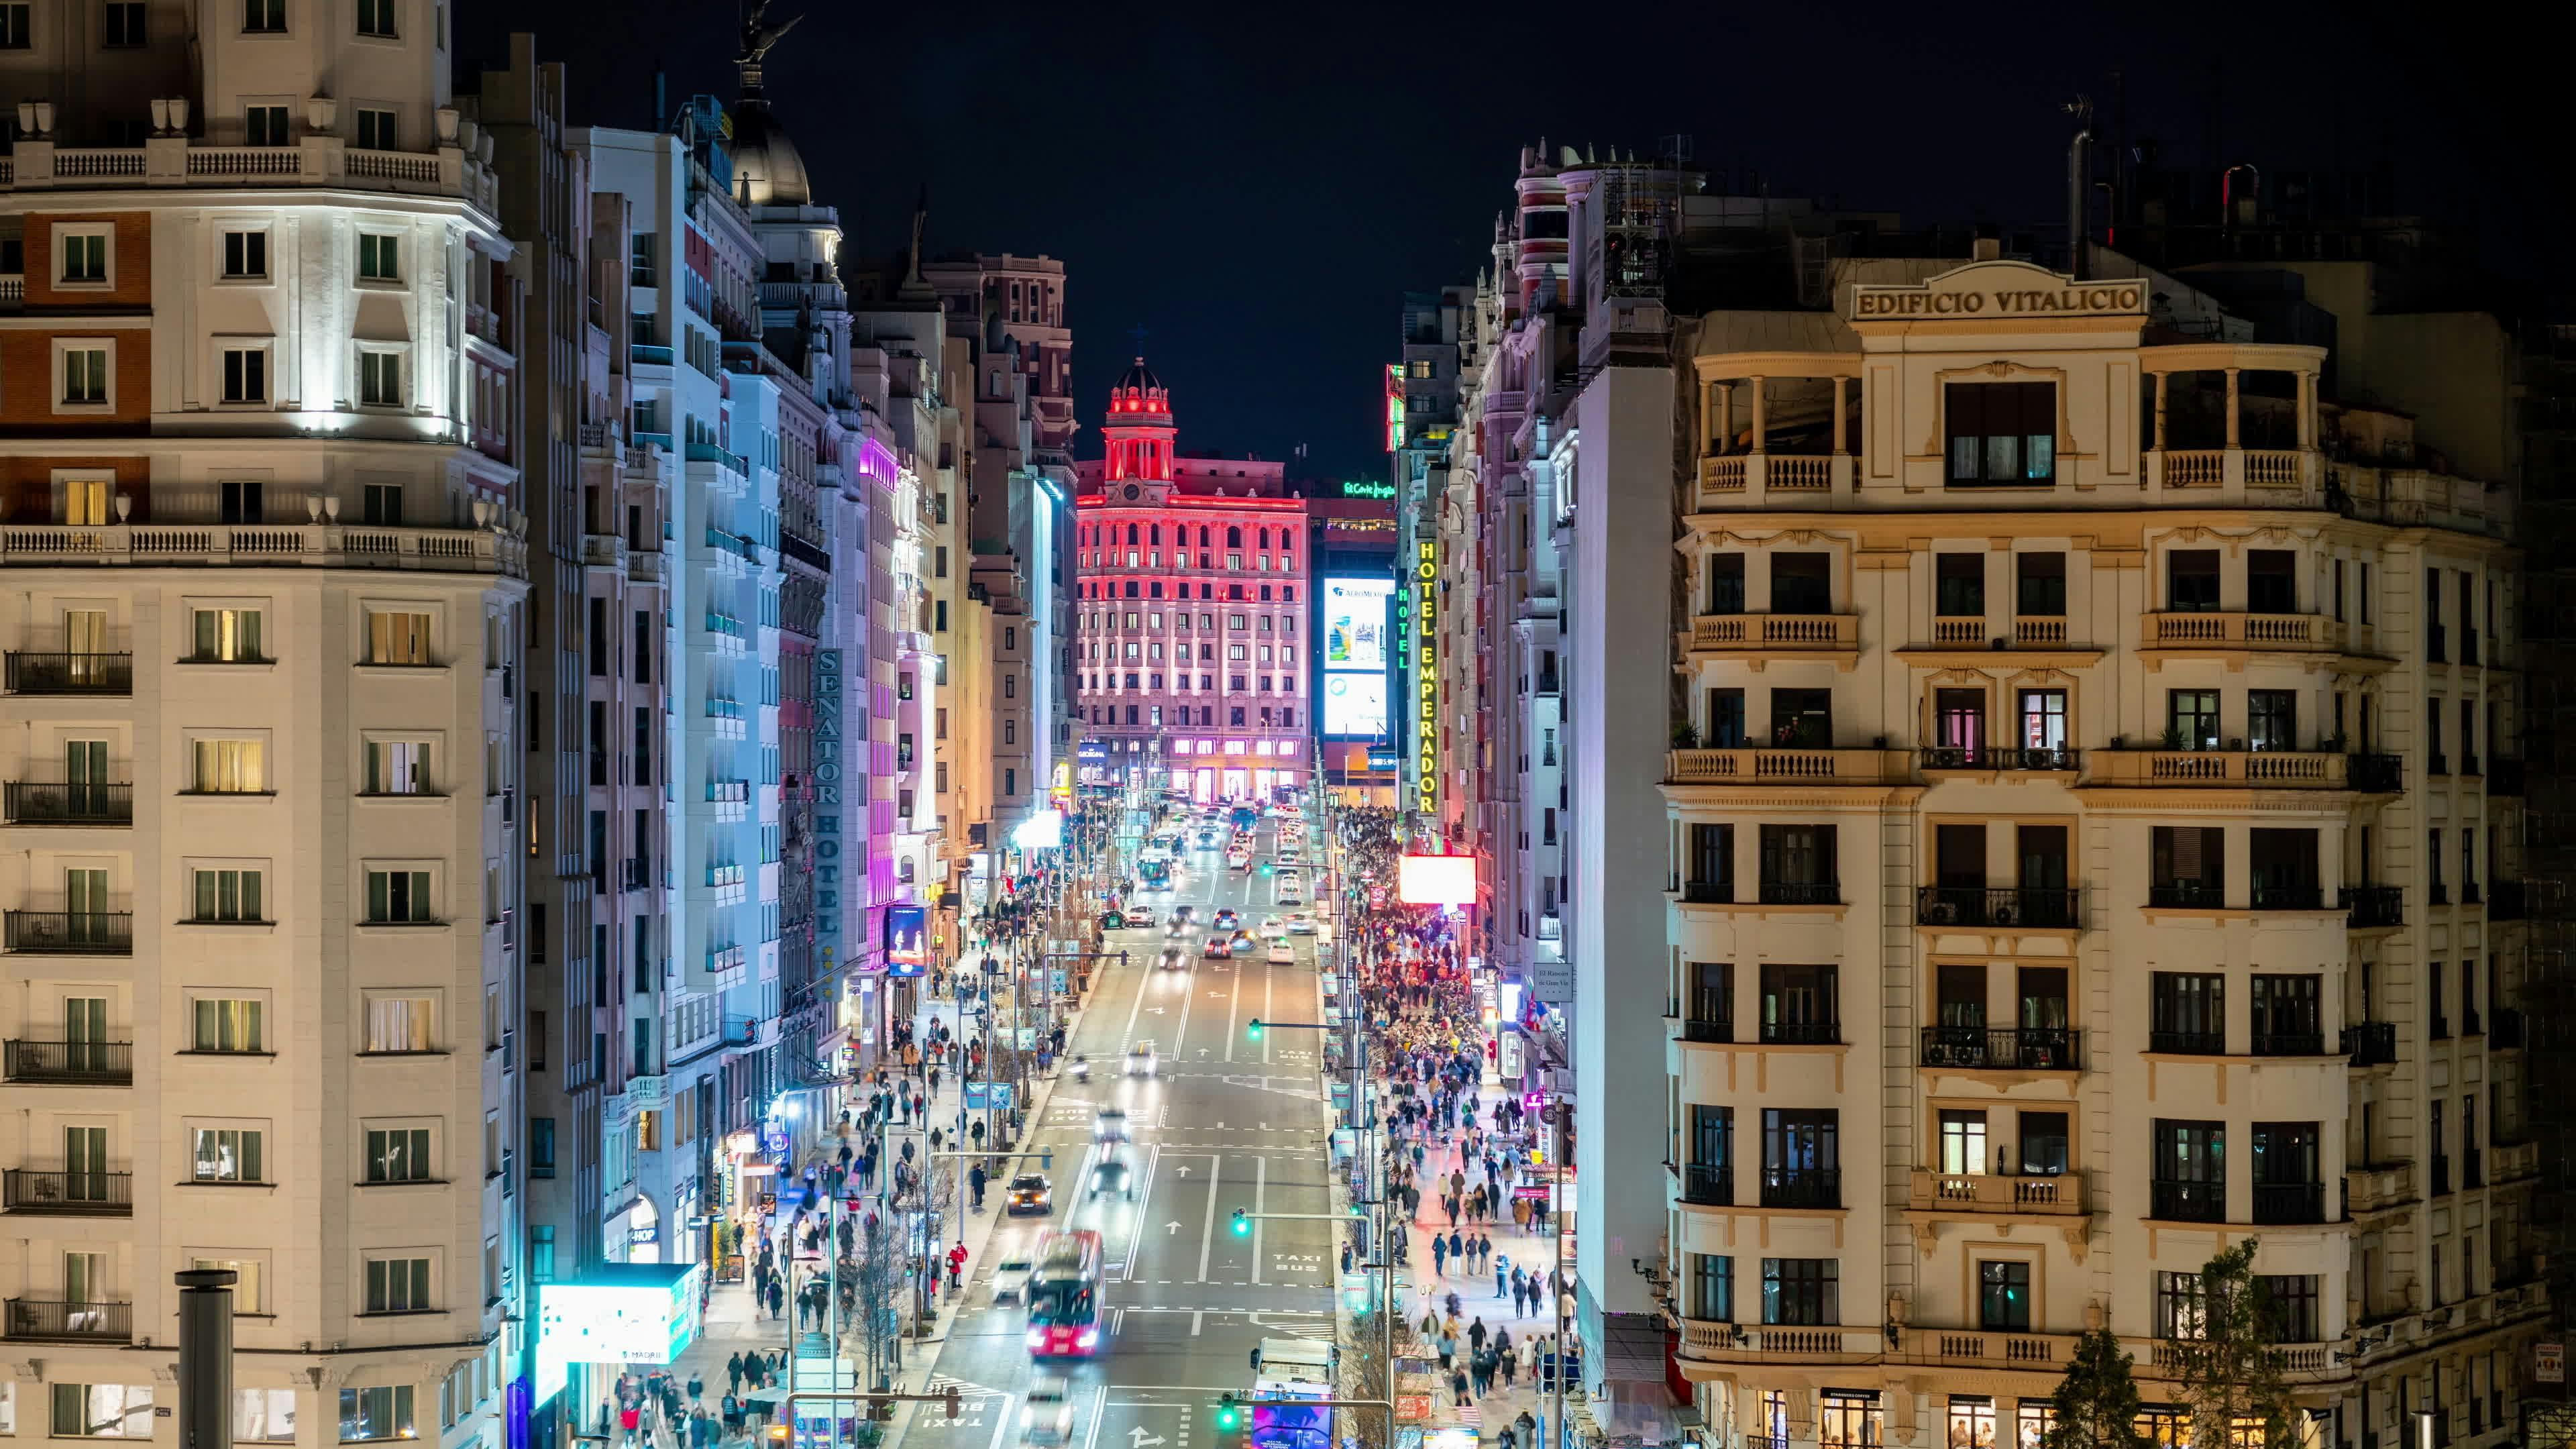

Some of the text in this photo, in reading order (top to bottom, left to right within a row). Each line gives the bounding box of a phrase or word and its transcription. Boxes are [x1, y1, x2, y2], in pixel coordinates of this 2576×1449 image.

[1858, 287, 2139, 315] EDIFICIO VITALICIO
[1344, 482, 1353, 493] El
[1354, 482, 1373, 494] Corte
[1399, 589, 1408, 668] HOTEL
[1420, 543, 1435, 813] HOTEL EMPERADOR
[816, 652, 840, 934] SENATOR HOTEL
[922, 1417, 983, 1428] TAXI
